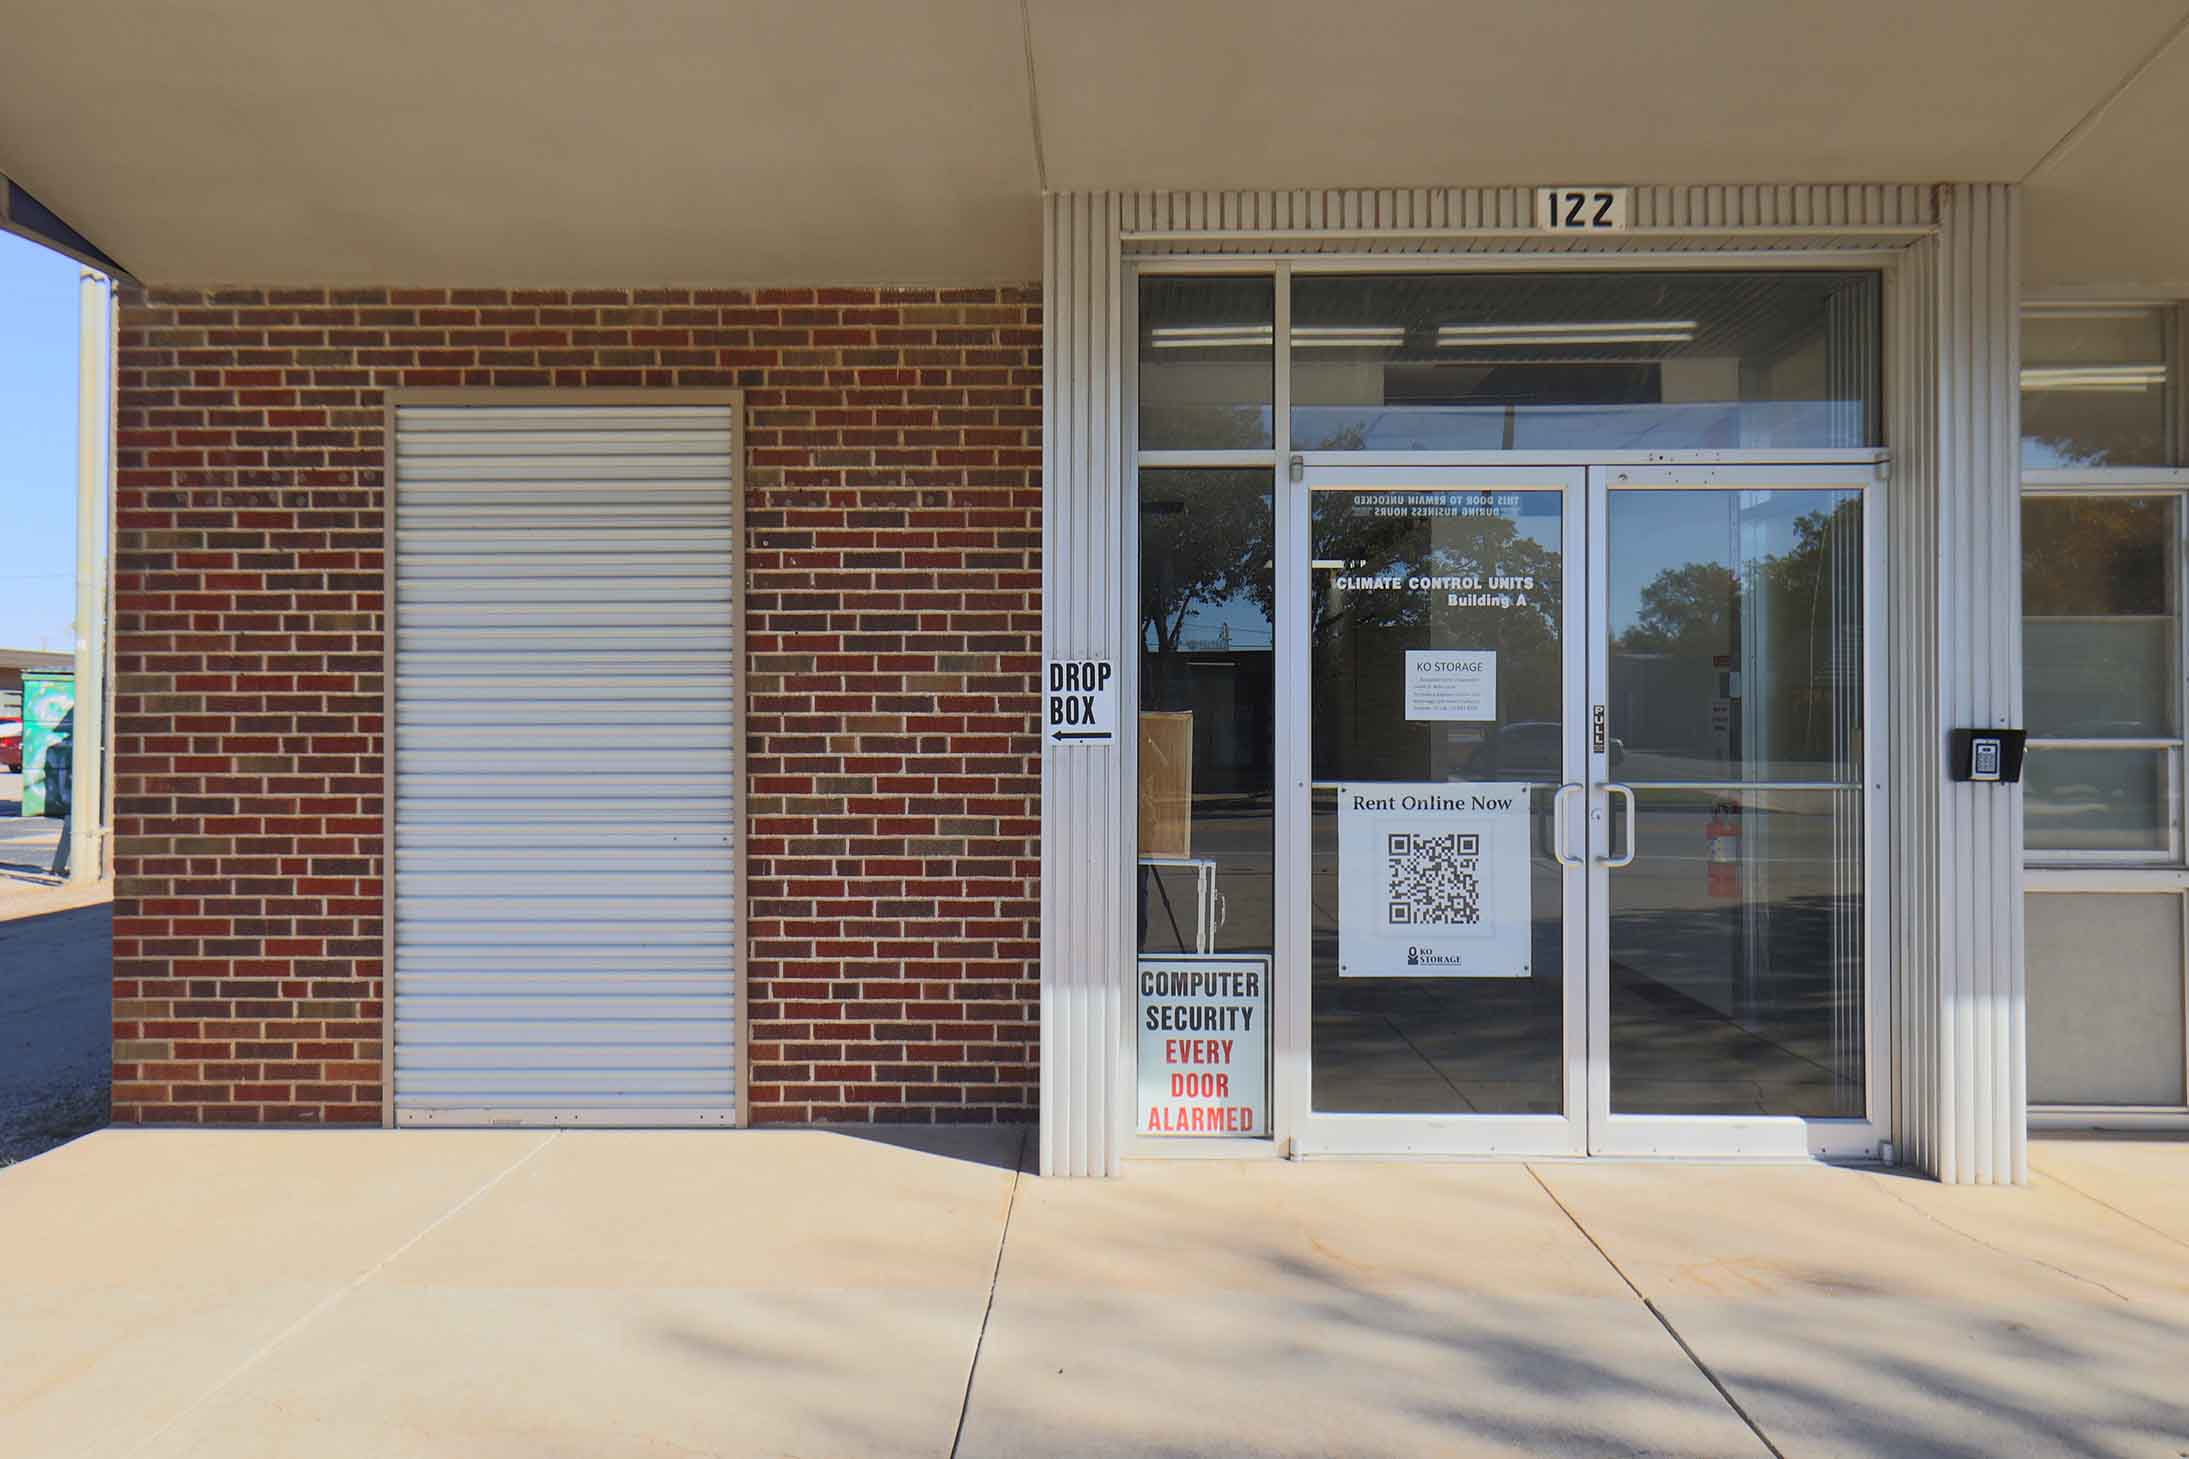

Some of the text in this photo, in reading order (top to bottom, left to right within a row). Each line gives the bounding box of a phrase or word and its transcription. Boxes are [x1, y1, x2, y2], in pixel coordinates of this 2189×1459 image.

[1549, 192, 1613, 227] 122
[1336, 576, 1534, 590] CLIMATE CONTROL UNITS
[1448, 594, 1527, 608] Building A
[1050, 662, 1111, 691] DROP
[1417, 662, 1484, 672] KO STORAGE
[1050, 696, 1095, 725] BOX
[1594, 706, 1604, 744] PULL
[1353, 796, 1512, 810] Rent Online Now
[1141, 971, 1259, 997] COMPUTER
[1146, 1005, 1253, 1031] SECURITY
[1166, 1039, 1233, 1064] EVERY
[1171, 1073, 1229, 1098] DOOR
[1147, 1107, 1253, 1132] ALARMED
